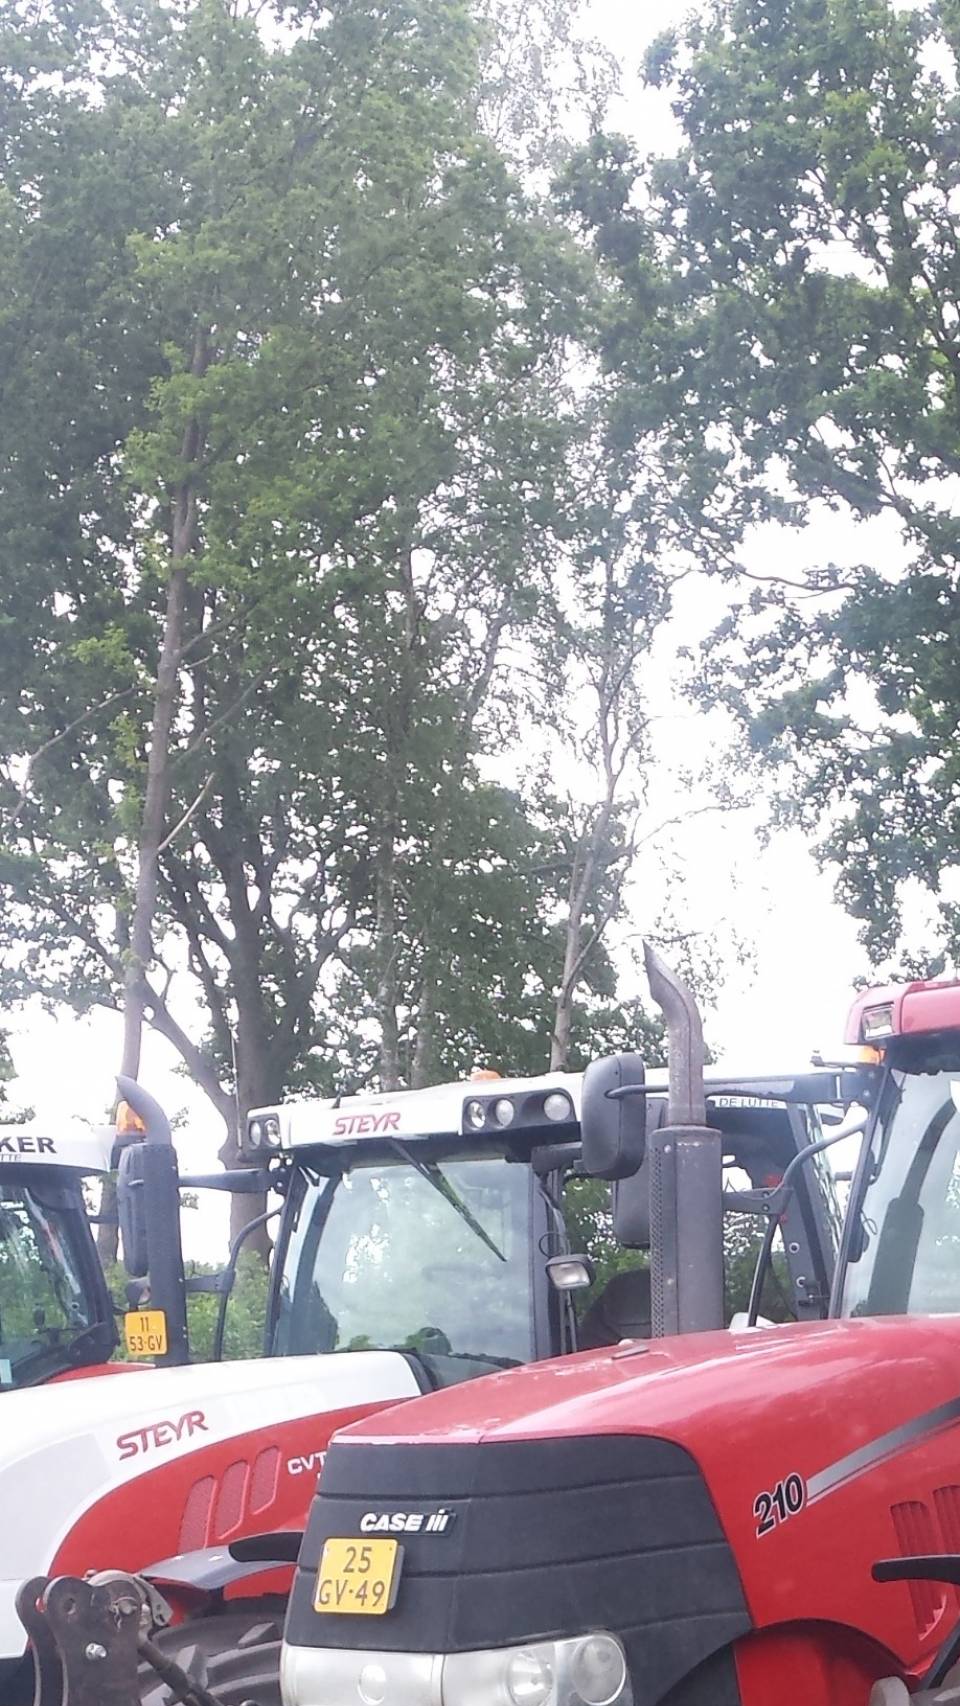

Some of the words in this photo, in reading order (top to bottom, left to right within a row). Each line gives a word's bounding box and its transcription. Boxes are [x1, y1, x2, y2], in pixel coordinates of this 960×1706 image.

[332, 1112, 401, 1136] STEYR
[140, 1316, 149, 1332] 11
[116, 1410, 209, 1461] STEYR
[753, 1472, 804, 1538] 210
[360, 1513, 424, 1532] CASE
[343, 1546, 373, 1574] 25
